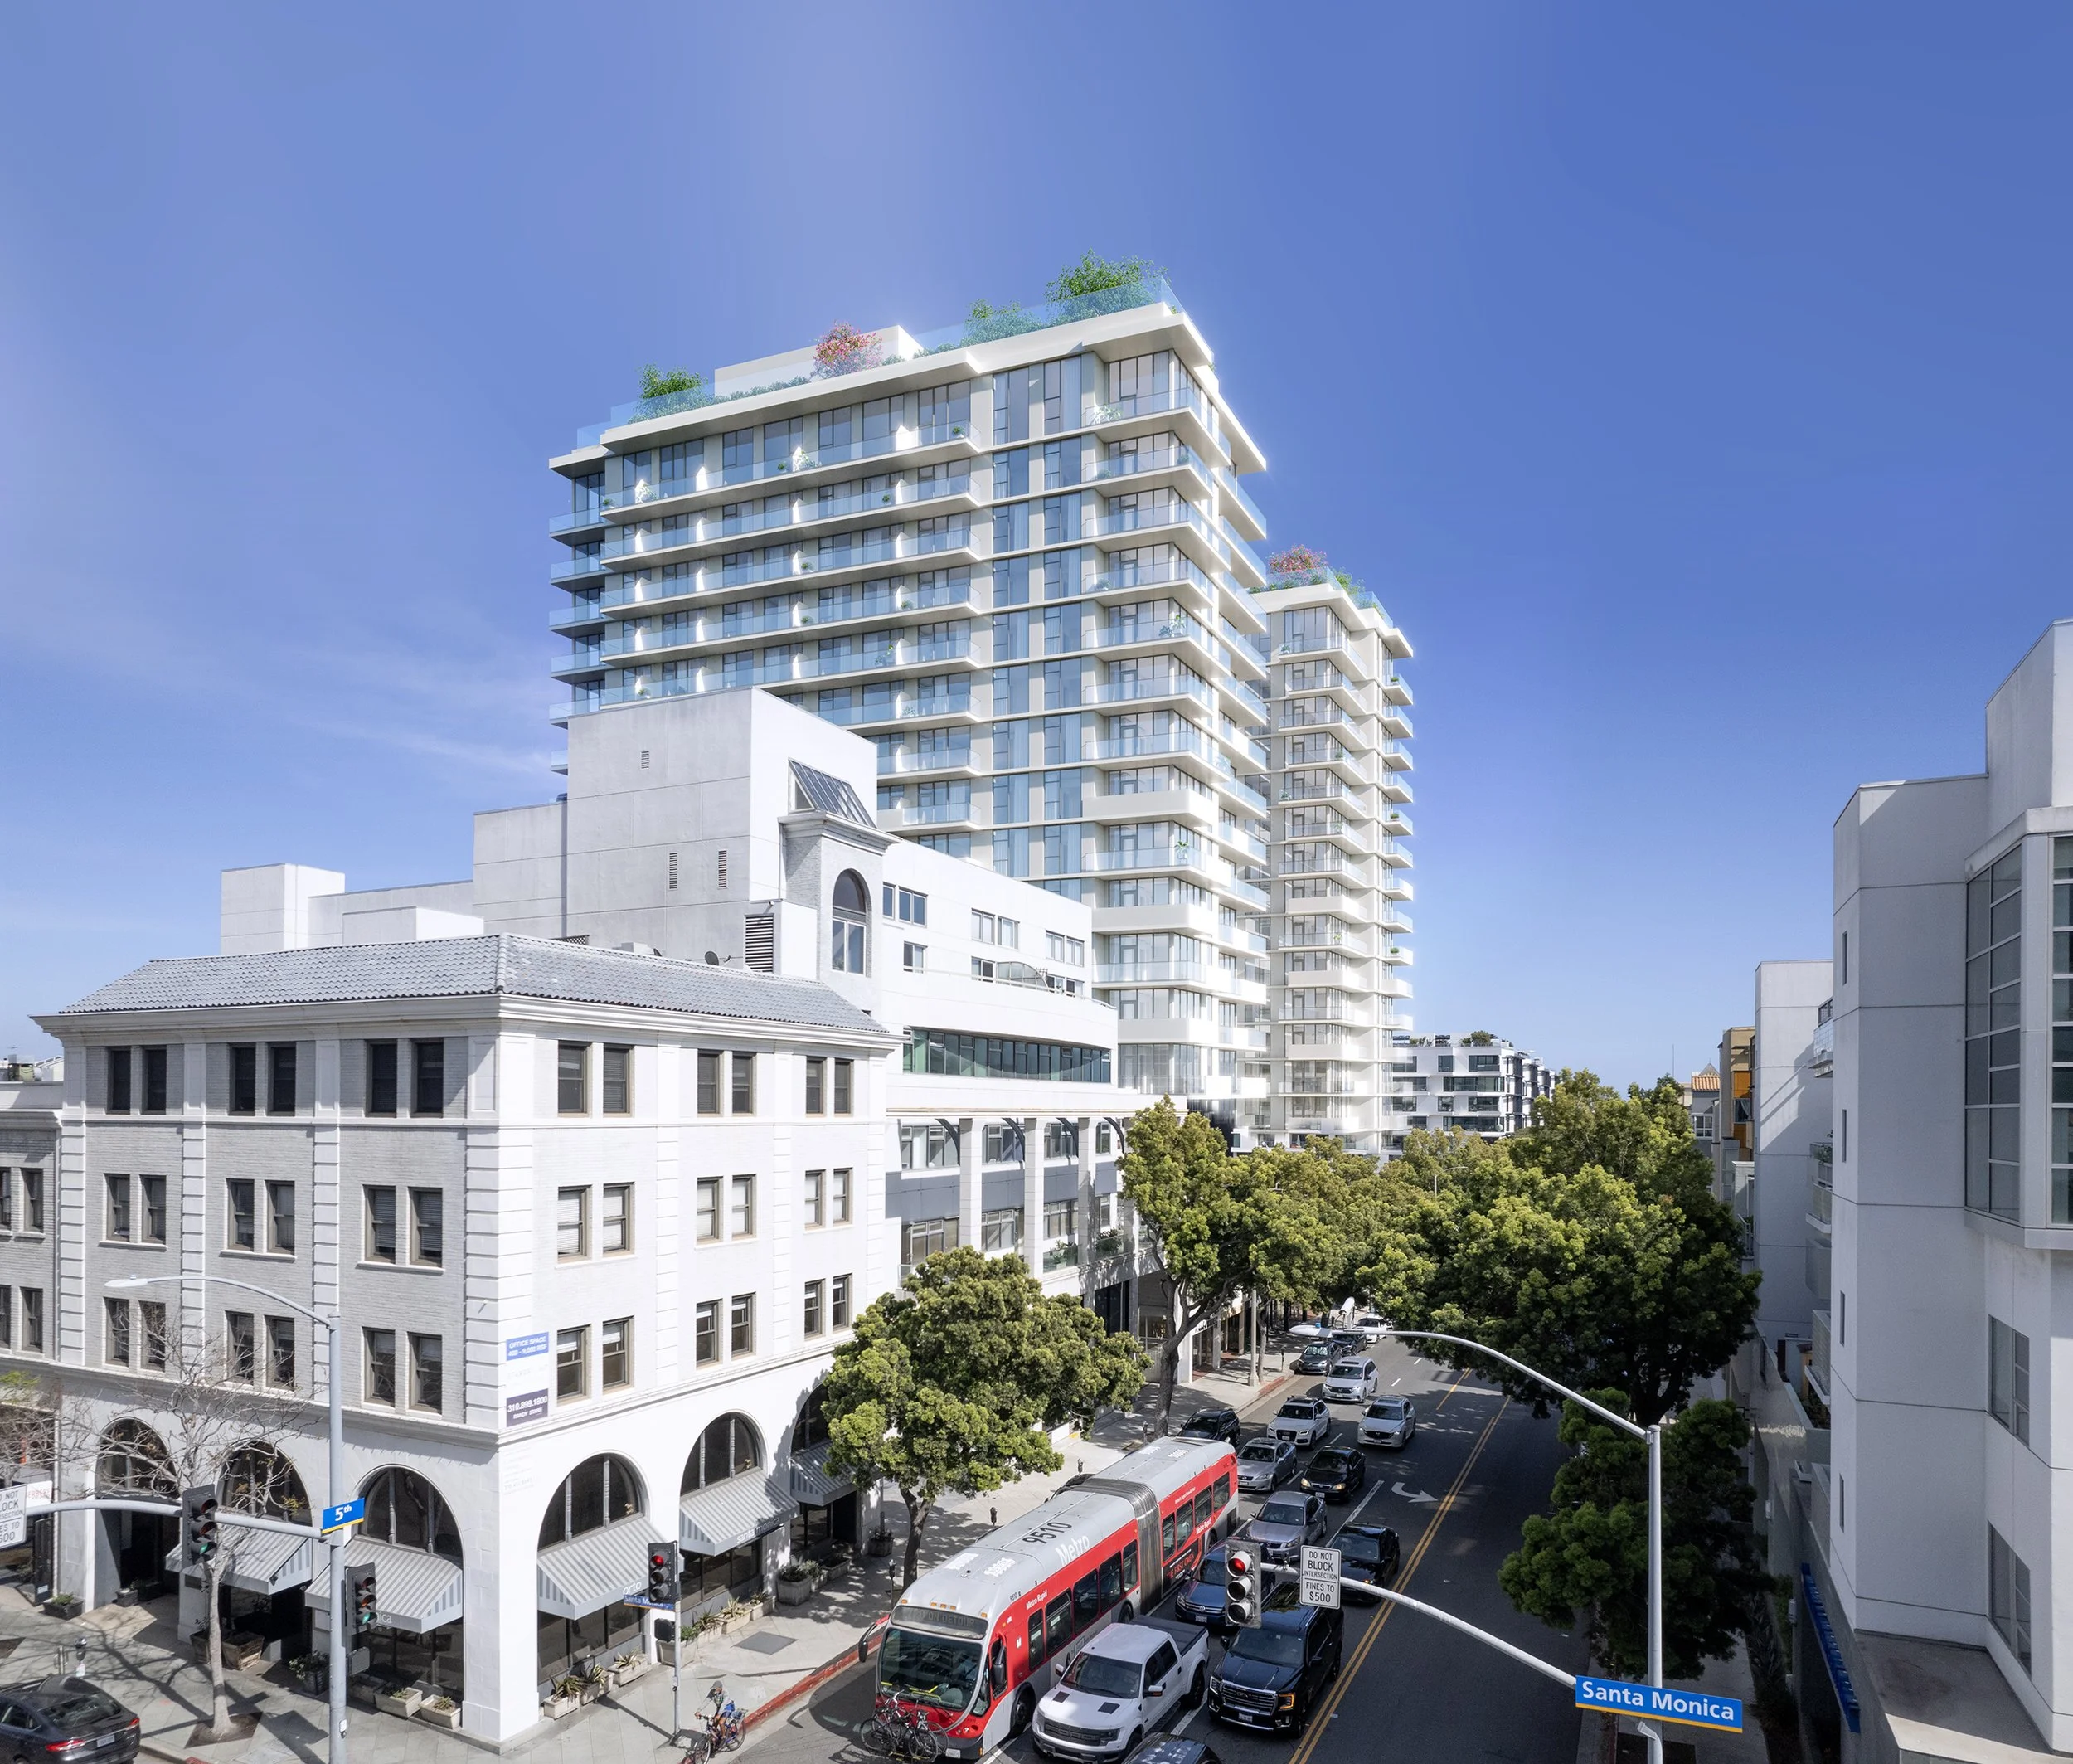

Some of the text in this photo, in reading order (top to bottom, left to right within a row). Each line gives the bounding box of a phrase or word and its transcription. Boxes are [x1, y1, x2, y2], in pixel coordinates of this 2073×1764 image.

[509, 1336, 547, 1349] OFFICE SPACE
[335, 1504, 352, 1522] 5th
[1022, 1522, 1073, 1544] 9510
[1056, 1535, 1090, 1566] Metro
[1308, 1550, 1333, 1561] DO NOT
[1308, 1560, 1333, 1572] BLOCK
[1304, 1570, 1337, 1580] INTERSECTION
[1306, 1582, 1335, 1593] FINES TO
[1309, 1591, 1331, 1603] $500
[1582, 1681, 1734, 1721] Santa Monica
